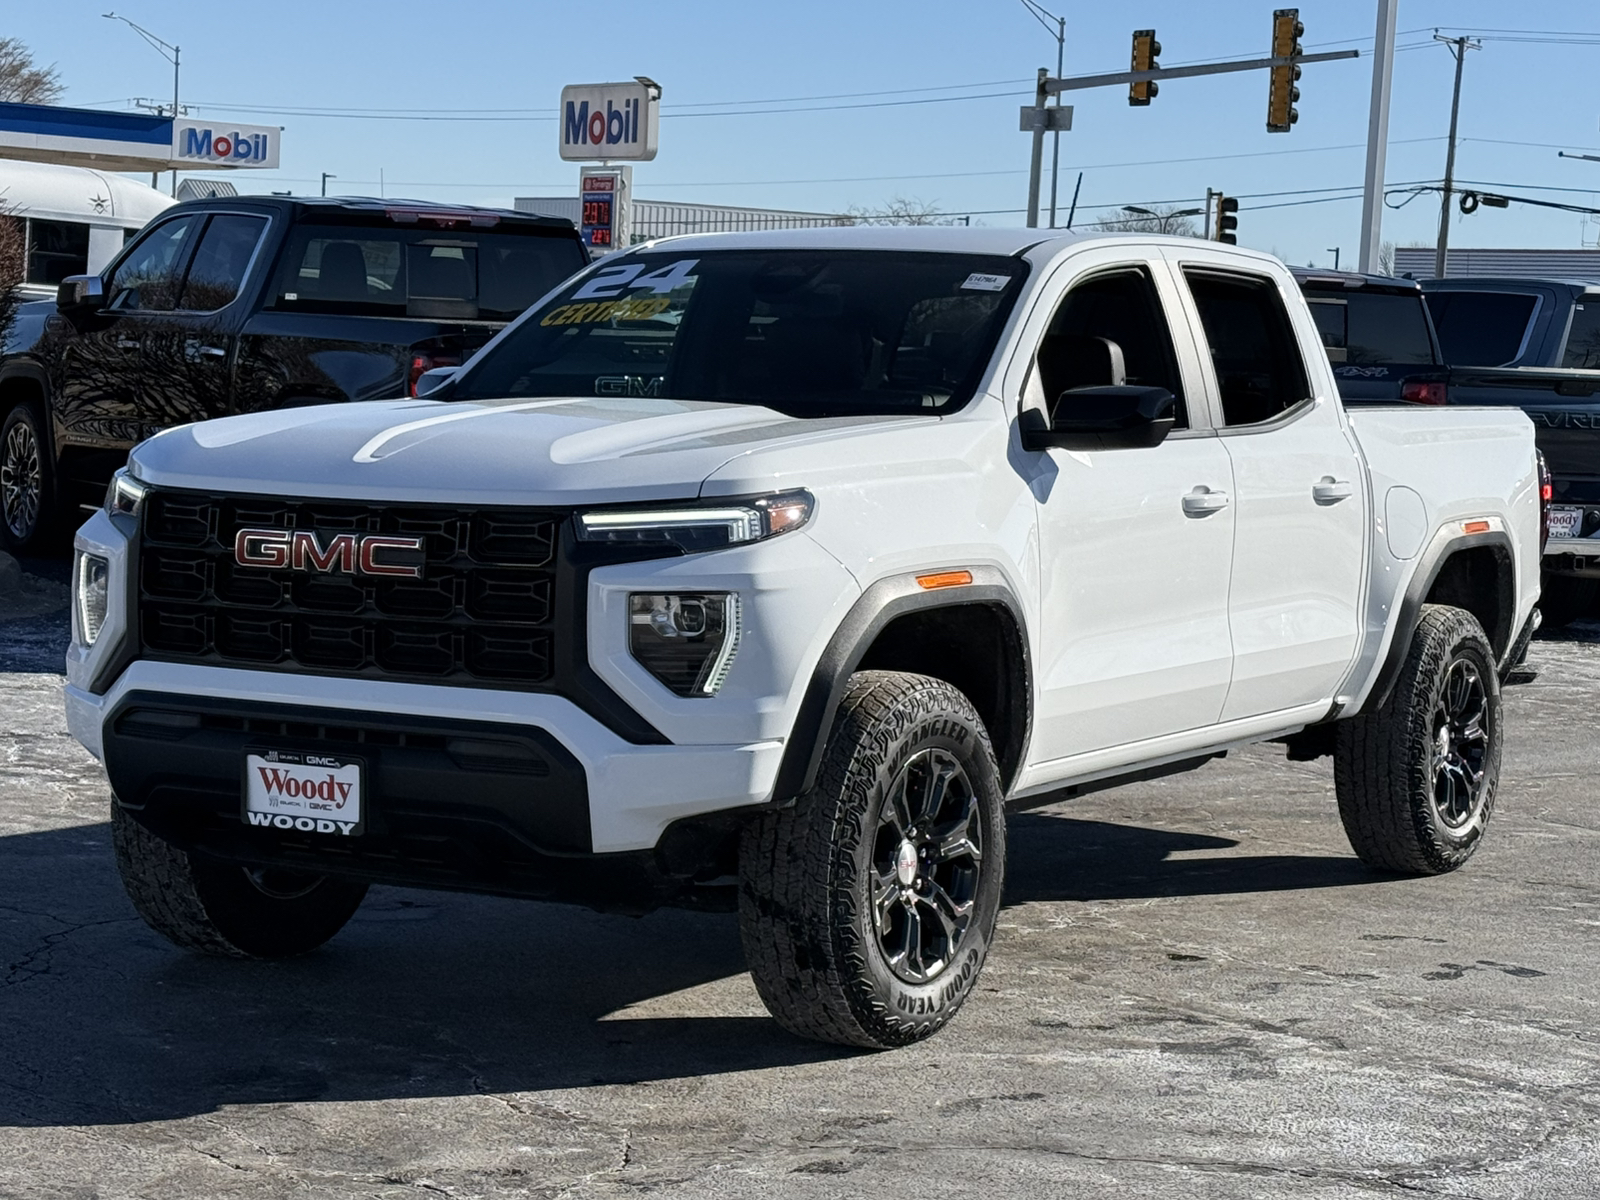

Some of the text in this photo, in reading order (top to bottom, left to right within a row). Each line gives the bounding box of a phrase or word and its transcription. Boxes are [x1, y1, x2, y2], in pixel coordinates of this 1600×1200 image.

[565, 98, 639, 145] Mobil
[185, 127, 268, 161] Mobil
[570, 259, 700, 300] 24
[540, 298, 671, 326] CERTIFIED
[235, 528, 423, 578] GMC
[306, 756, 336, 766] GMC
[887, 719, 968, 779] WRANGLER
[257, 766, 354, 810] Woody
[309, 802, 333, 811] GMC
[247, 812, 356, 835] WOODY
[897, 948, 979, 1015] GOOD YEAR
